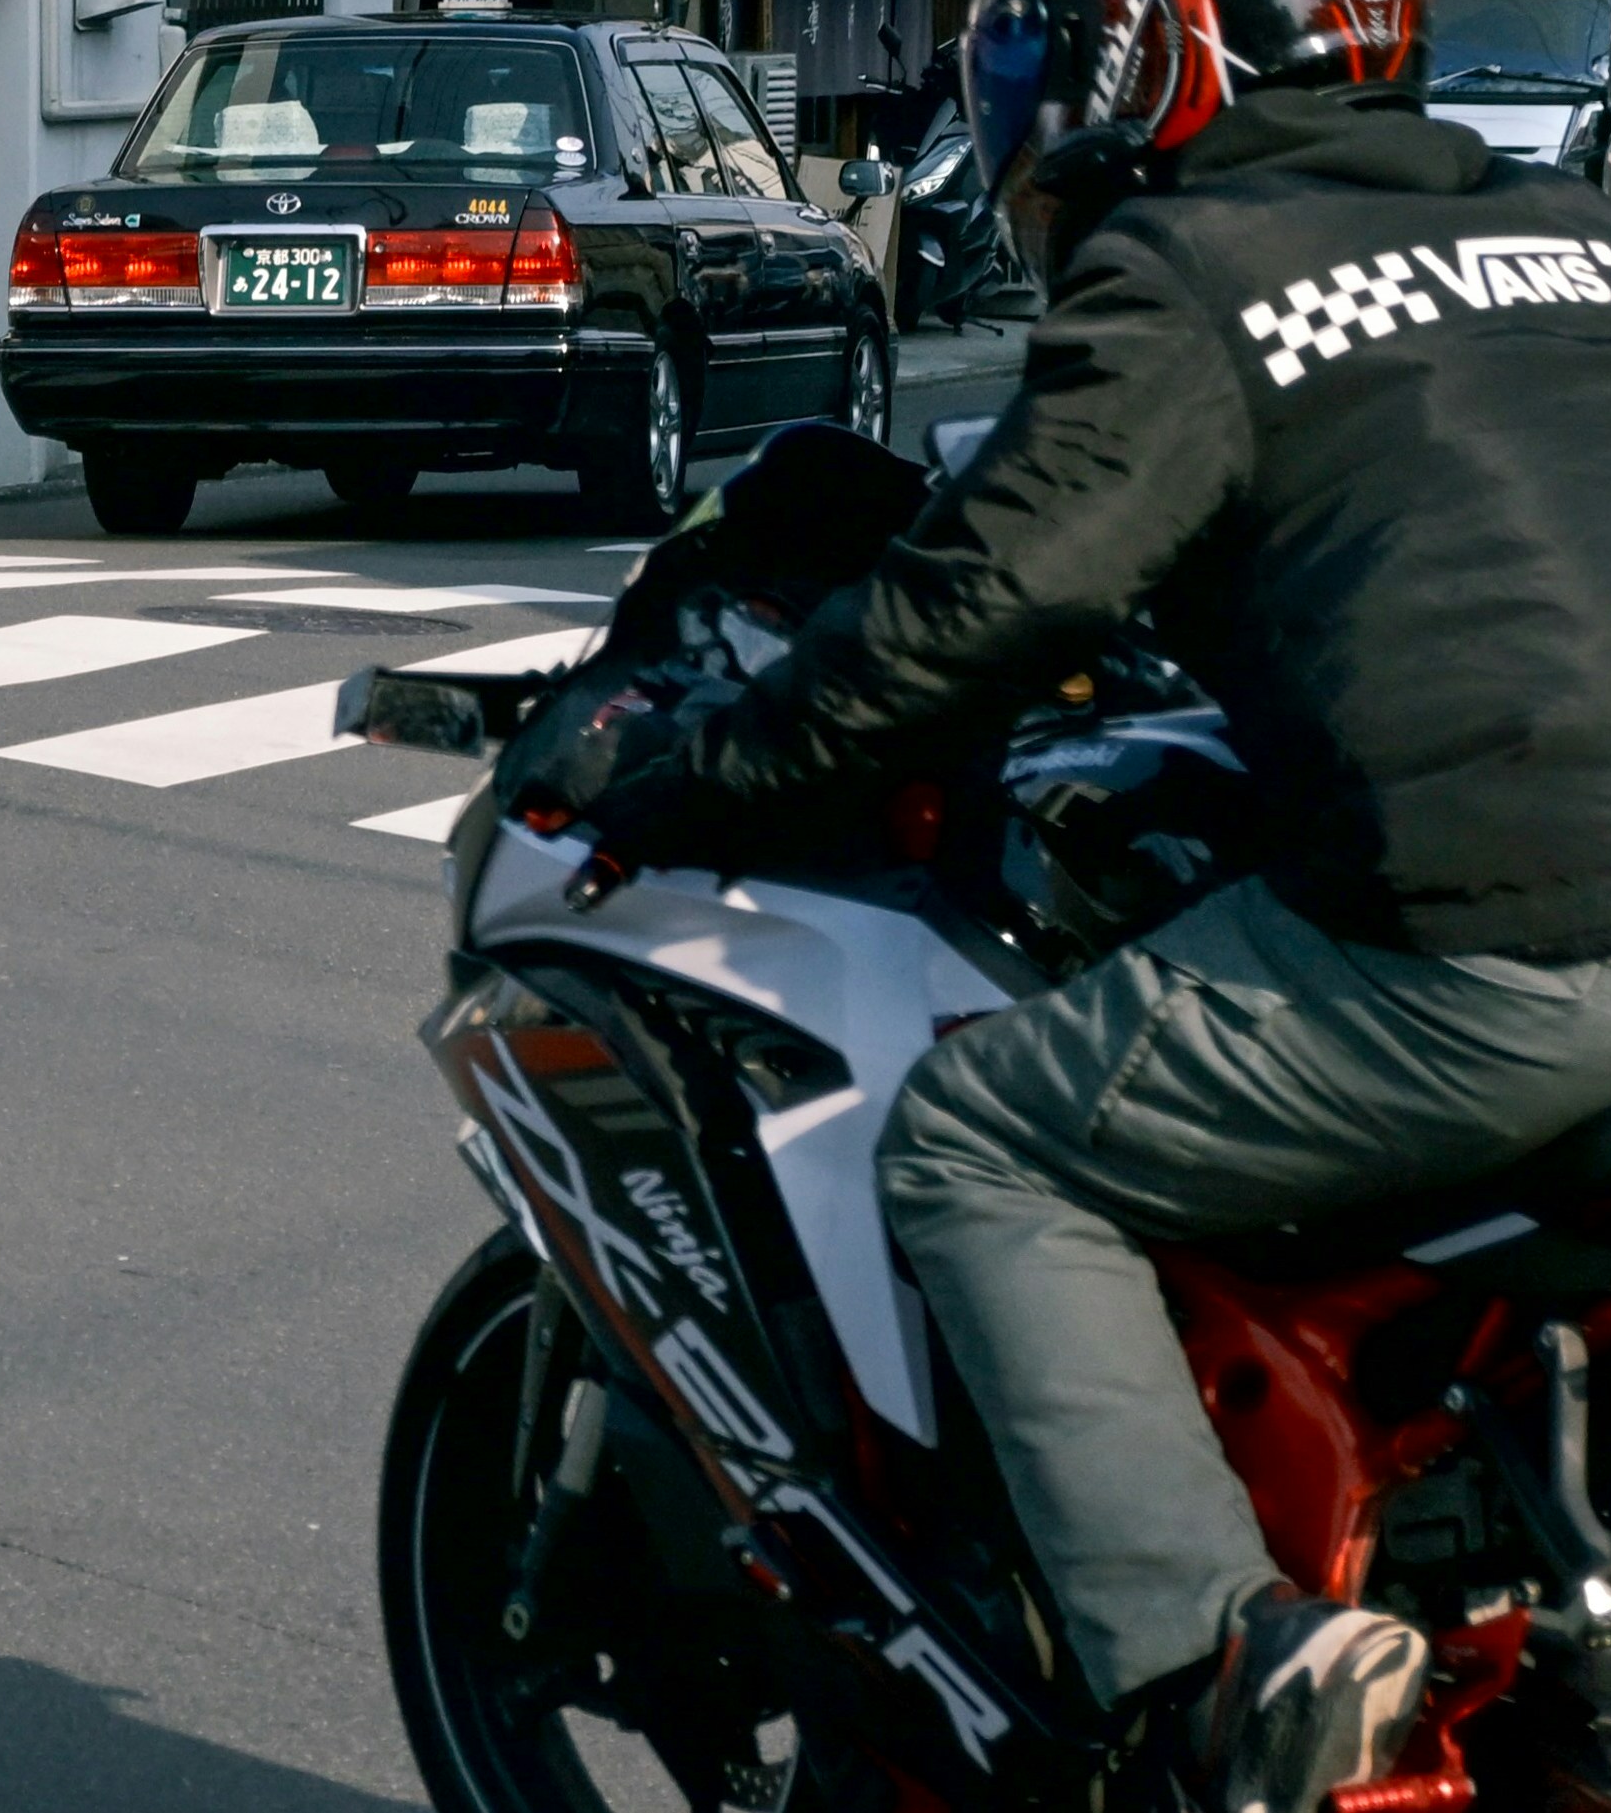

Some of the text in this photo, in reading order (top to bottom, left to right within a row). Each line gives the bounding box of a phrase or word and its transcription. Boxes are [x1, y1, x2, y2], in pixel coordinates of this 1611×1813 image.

[454, 213, 510, 225] CROWN
[469, 198, 507, 215] 4044
[251, 268, 341, 301] 24-12
[619, 1168, 729, 1314] Ninja
